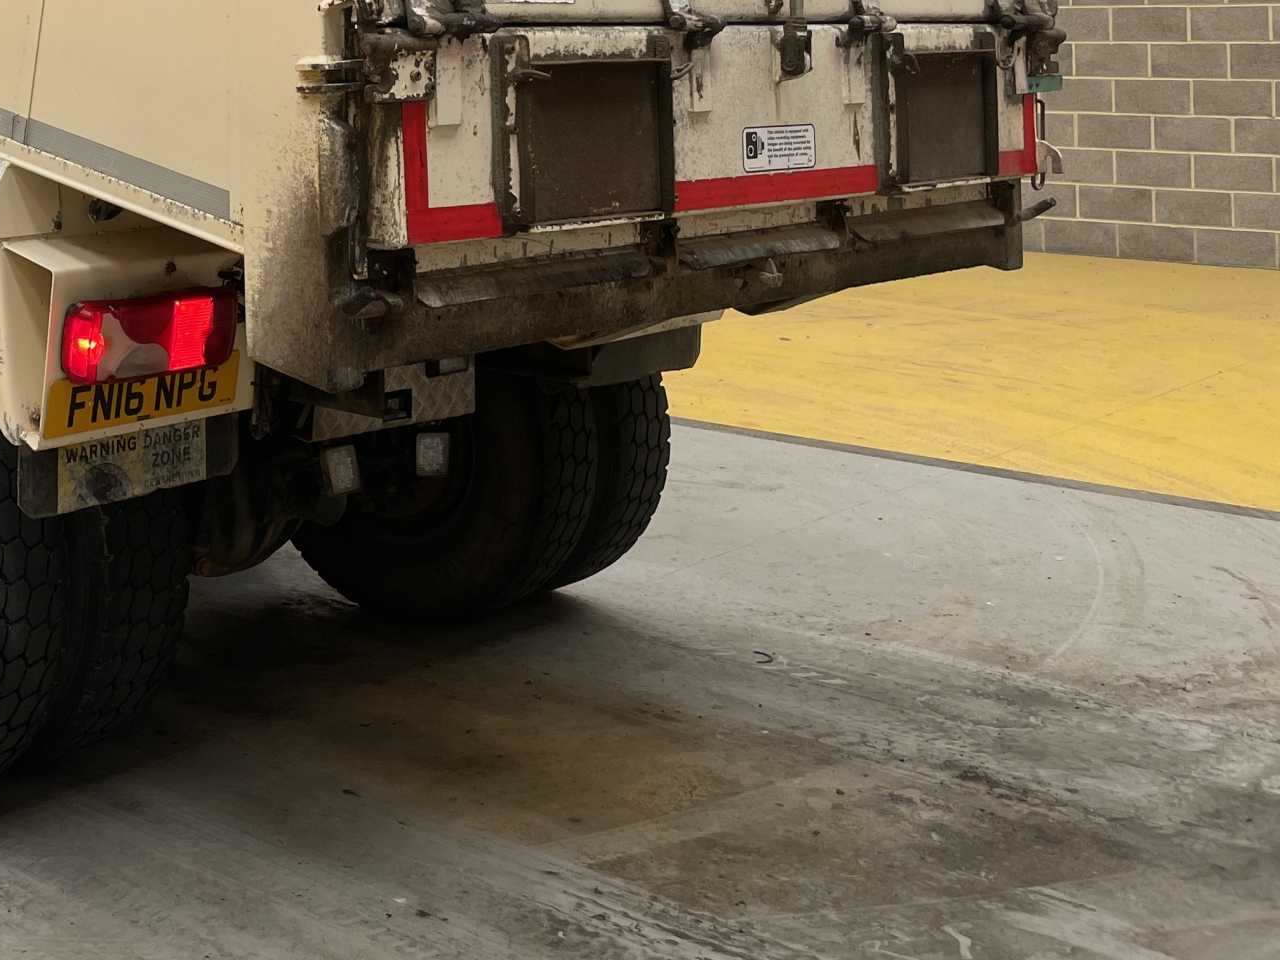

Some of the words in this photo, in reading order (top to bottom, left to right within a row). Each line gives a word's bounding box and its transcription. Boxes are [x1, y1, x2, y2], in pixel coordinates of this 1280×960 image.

[66, 382, 146, 428] FN16
[153, 366, 220, 412] NPG
[65, 436, 138, 464] WARNING
[142, 424, 202, 449] DANGER
[150, 446, 192, 468] ZONE
